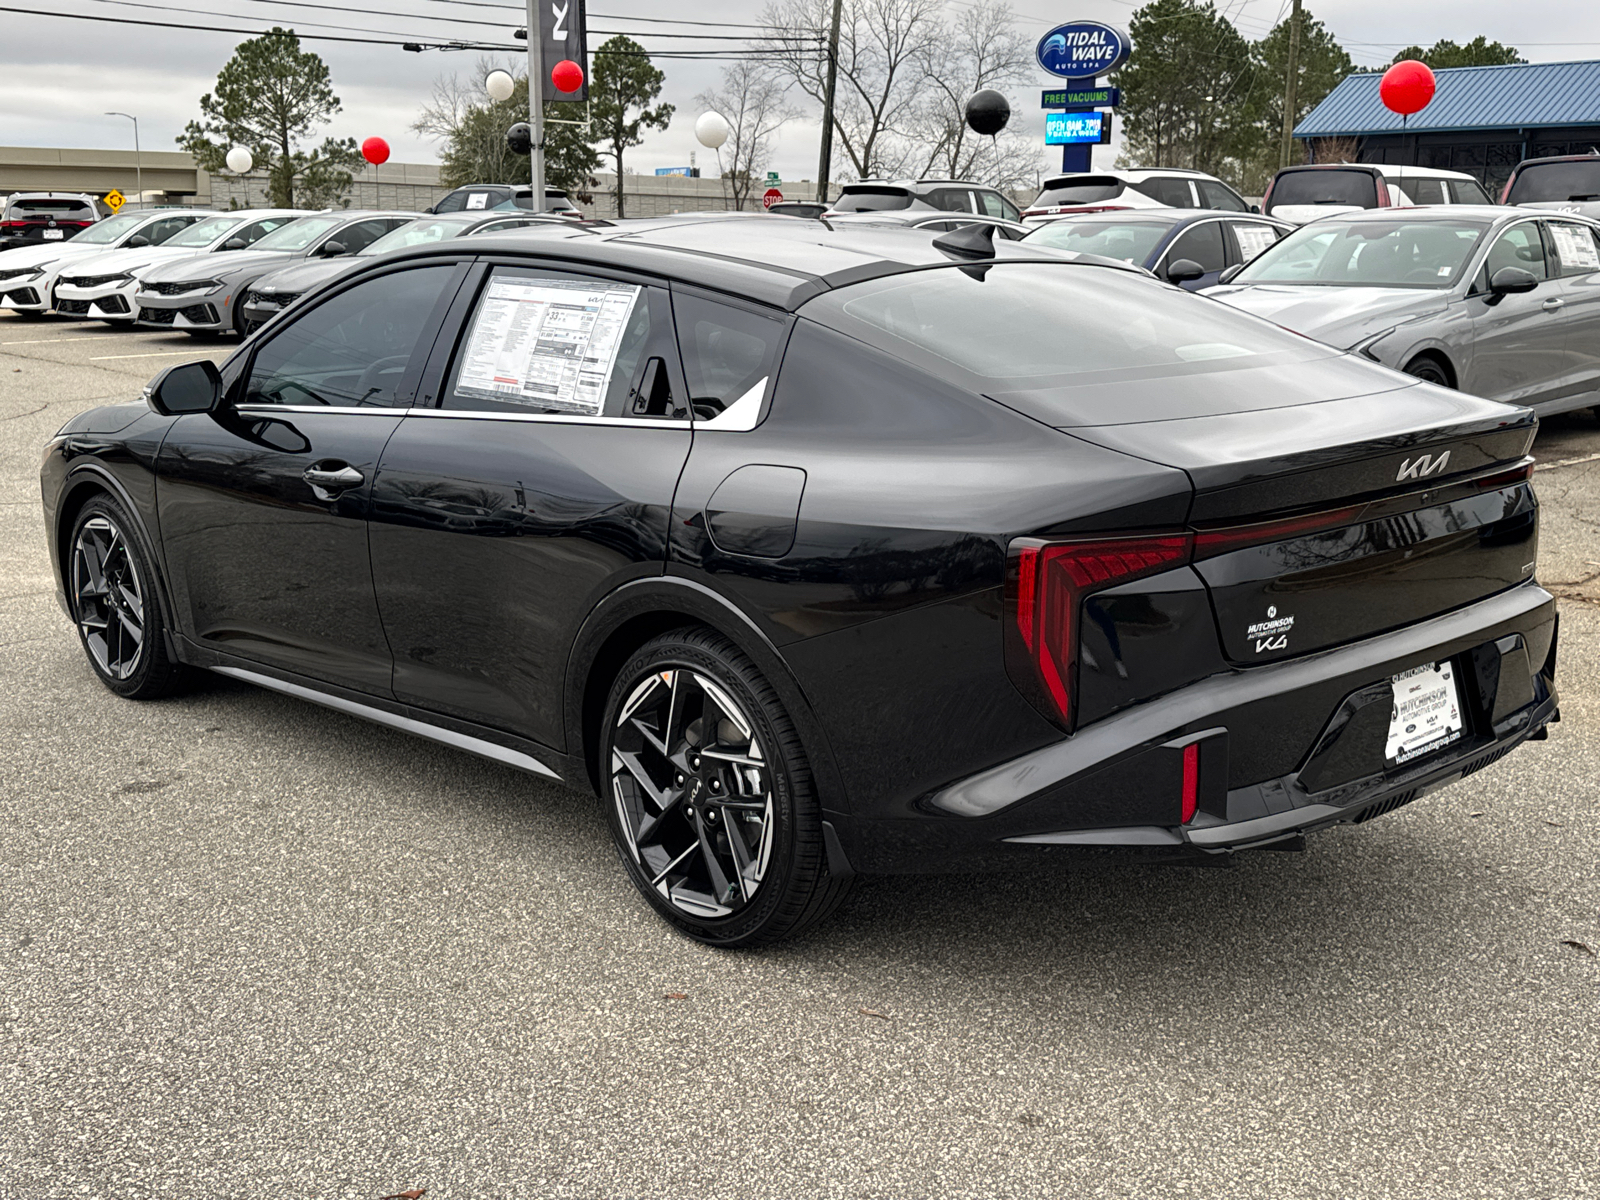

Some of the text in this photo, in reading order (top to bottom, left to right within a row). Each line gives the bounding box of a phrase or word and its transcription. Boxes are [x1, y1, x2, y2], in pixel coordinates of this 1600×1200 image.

[1067, 31, 1106, 46] TIDAL
[1072, 45, 1115, 61] WAVE
[1044, 91, 1108, 104] FREE VACUUMS
[1047, 120, 1065, 132] OPEN
[764, 196, 782, 205] STOP
[1395, 450, 1450, 482] KIA
[1247, 616, 1294, 634] HUTCHINSON
[1255, 634, 1288, 653] K4
[1400, 661, 1436, 680] HUTCHINSON
[1400, 686, 1448, 716] HUTCHINSON
[1402, 699, 1447, 723] AUTOMOTIVE GROUP
